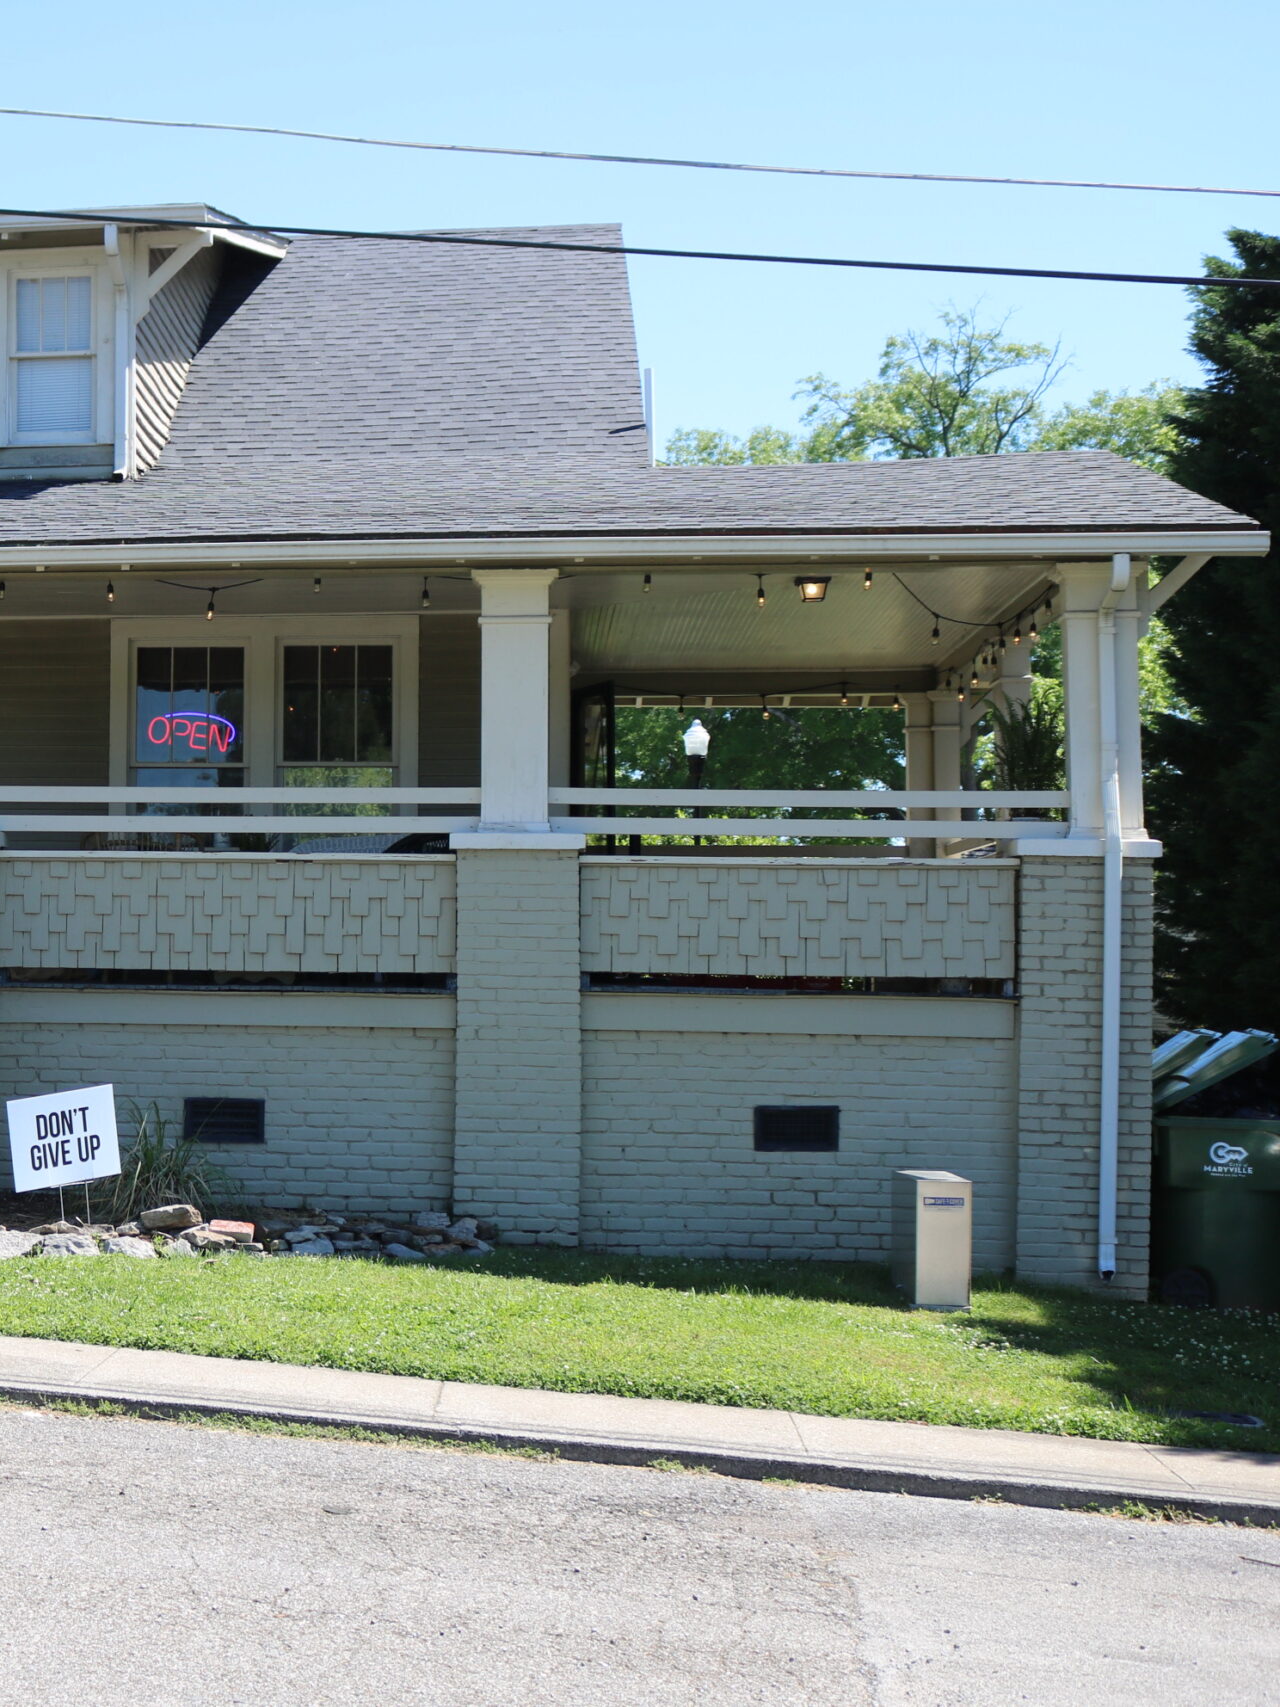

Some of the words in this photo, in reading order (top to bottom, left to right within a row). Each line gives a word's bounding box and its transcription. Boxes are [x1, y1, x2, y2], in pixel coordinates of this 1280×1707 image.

[148, 716, 231, 752] OPEN
[35, 1106, 89, 1140] DON'T
[30, 1139, 72, 1171] GIVE
[77, 1134, 101, 1163] UP
[1203, 1165, 1253, 1174] MARYVILLE
